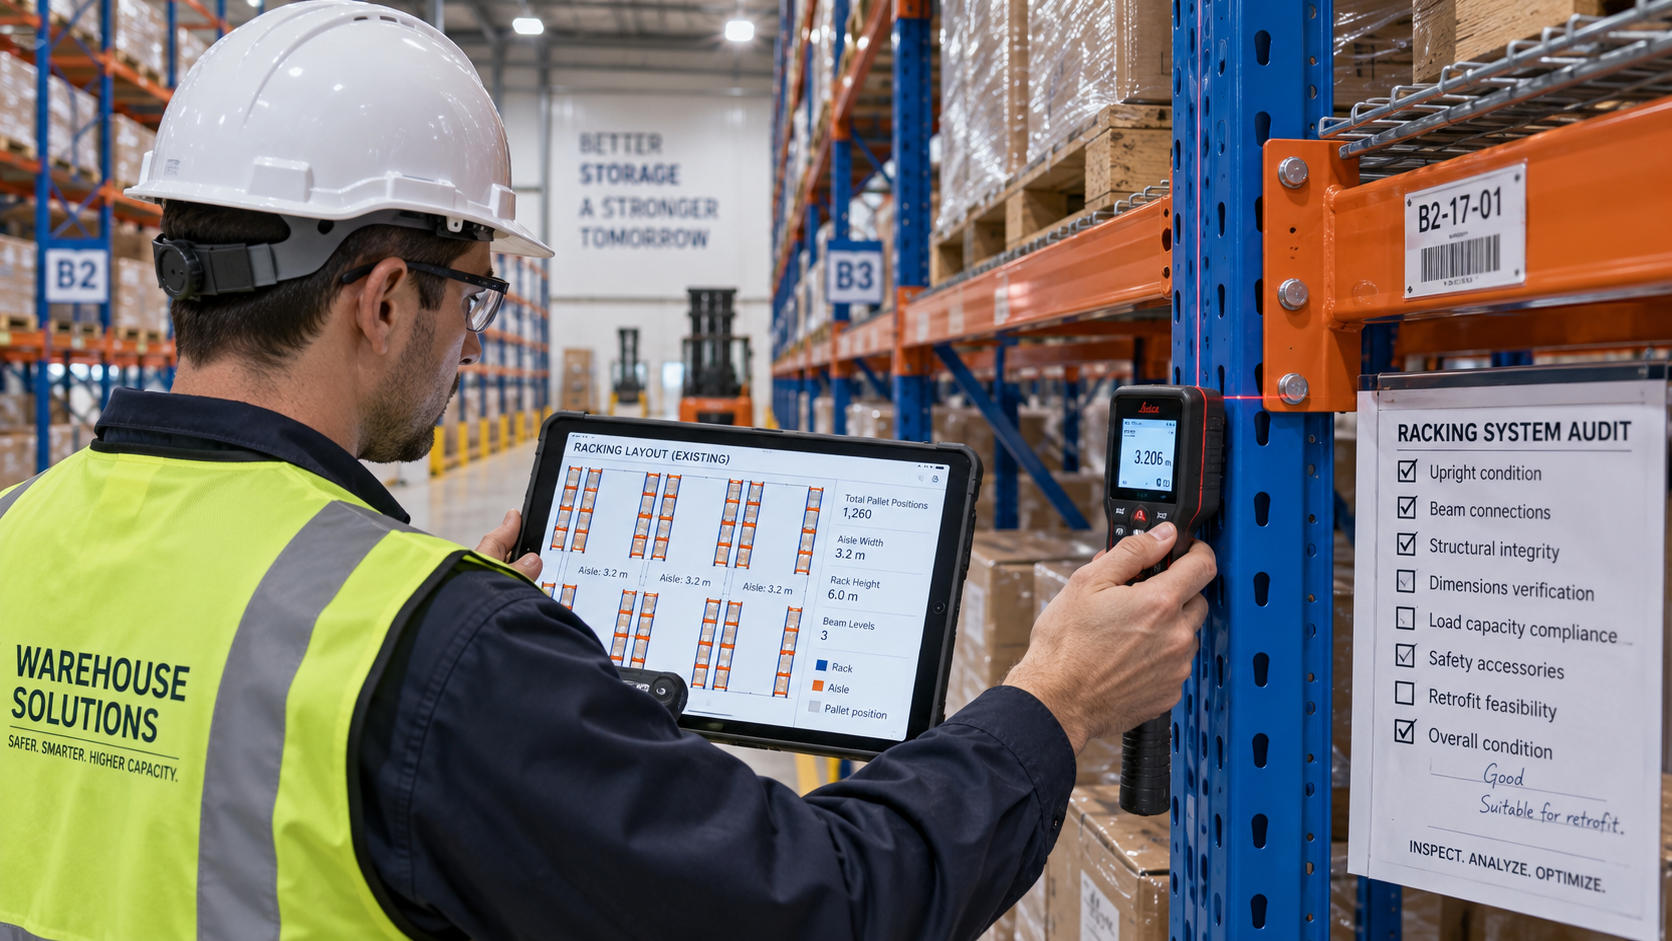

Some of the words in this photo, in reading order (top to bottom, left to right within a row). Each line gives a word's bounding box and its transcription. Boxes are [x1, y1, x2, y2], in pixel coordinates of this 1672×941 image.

[579, 133, 663, 155] BETTER
[580, 164, 681, 185] STORAGE
[579, 197, 594, 218] A
[602, 197, 719, 219] STRONGER
[1419, 186, 1500, 233] B2-17-01
[580, 228, 710, 248] TOMORROW
[57, 259, 97, 289] B2
[837, 261, 873, 289] B3
[1398, 423, 1477, 442] RACKING
[1484, 422, 1561, 442] SYSTEM
[1568, 421, 1632, 441] AUDIT
[574, 442, 622, 455] RACKING
[625, 447, 668, 459] LAYOUT
[671, 451, 730, 465] (EXISTING)
[1134, 450, 1163, 465] 3.206
[1430, 464, 1476, 483] Upright
[1480, 466, 1541, 481] condition
[845, 494, 865, 504] Total
[867, 496, 889, 506] Pallet
[892, 499, 929, 510] Positions
[1430, 502, 1465, 517] Beam
[1470, 504, 1551, 520] connections
[843, 508, 872, 519] 1,260
[837, 535, 857, 545] Aisle
[859, 537, 884, 547] Width
[1430, 538, 1495, 556] Structural
[1500, 541, 1560, 563] integrity
[835, 548, 852, 559] 3.2
[855, 552, 865, 560] m
[578, 566, 601, 576] Aisle:
[603, 569, 617, 578] 3.2
[660, 573, 683, 584] Aisle:
[685, 576, 700, 585] 3.2
[831, 576, 850, 586] Rack
[853, 577, 880, 589] Height
[743, 582, 766, 593] Aisle:
[768, 585, 782, 594] 3.2
[784, 587, 793, 595] m
[828, 589, 844, 600] 6.0
[848, 592, 858, 602] m
[1430, 575, 1508, 595] Dimensions
[1513, 582, 1594, 601] verification
[823, 617, 846, 627] Beam
[849, 618, 875, 631] Levels
[1430, 613, 1461, 630] Load
[1466, 618, 1525, 639] capacity
[1530, 624, 1618, 644] compliance
[821, 631, 828, 641] 3
[17, 645, 190, 702] WAREHOUSE
[832, 663, 853, 673] Rack
[1429, 650, 1473, 672] Safety
[1478, 659, 1564, 679] accessories
[828, 683, 849, 694] Aisle
[12, 687, 158, 742] SOLUTIONS
[825, 704, 849, 716] Pallet
[852, 707, 887, 720] position
[1429, 688, 1481, 710] Retrofit
[1486, 695, 1557, 722] feasibility
[1429, 728, 1477, 749] Overall
[1483, 736, 1552, 759] condition
[8, 735, 38, 752] SAFER.
[42, 741, 86, 762] SMARTER.
[89, 751, 125, 770] HIGHER
[128, 758, 178, 782] CAPACITY.
[1483, 763, 1524, 788] Good
[1480, 795, 1534, 819] Suitable
[1540, 802, 1561, 823] for
[1567, 811, 1624, 835] retrofit.
[1410, 840, 1464, 863] INSPECT.
[1469, 853, 1531, 877] ANALYZE.
[1536, 866, 1605, 893] OPTIMIZE.
